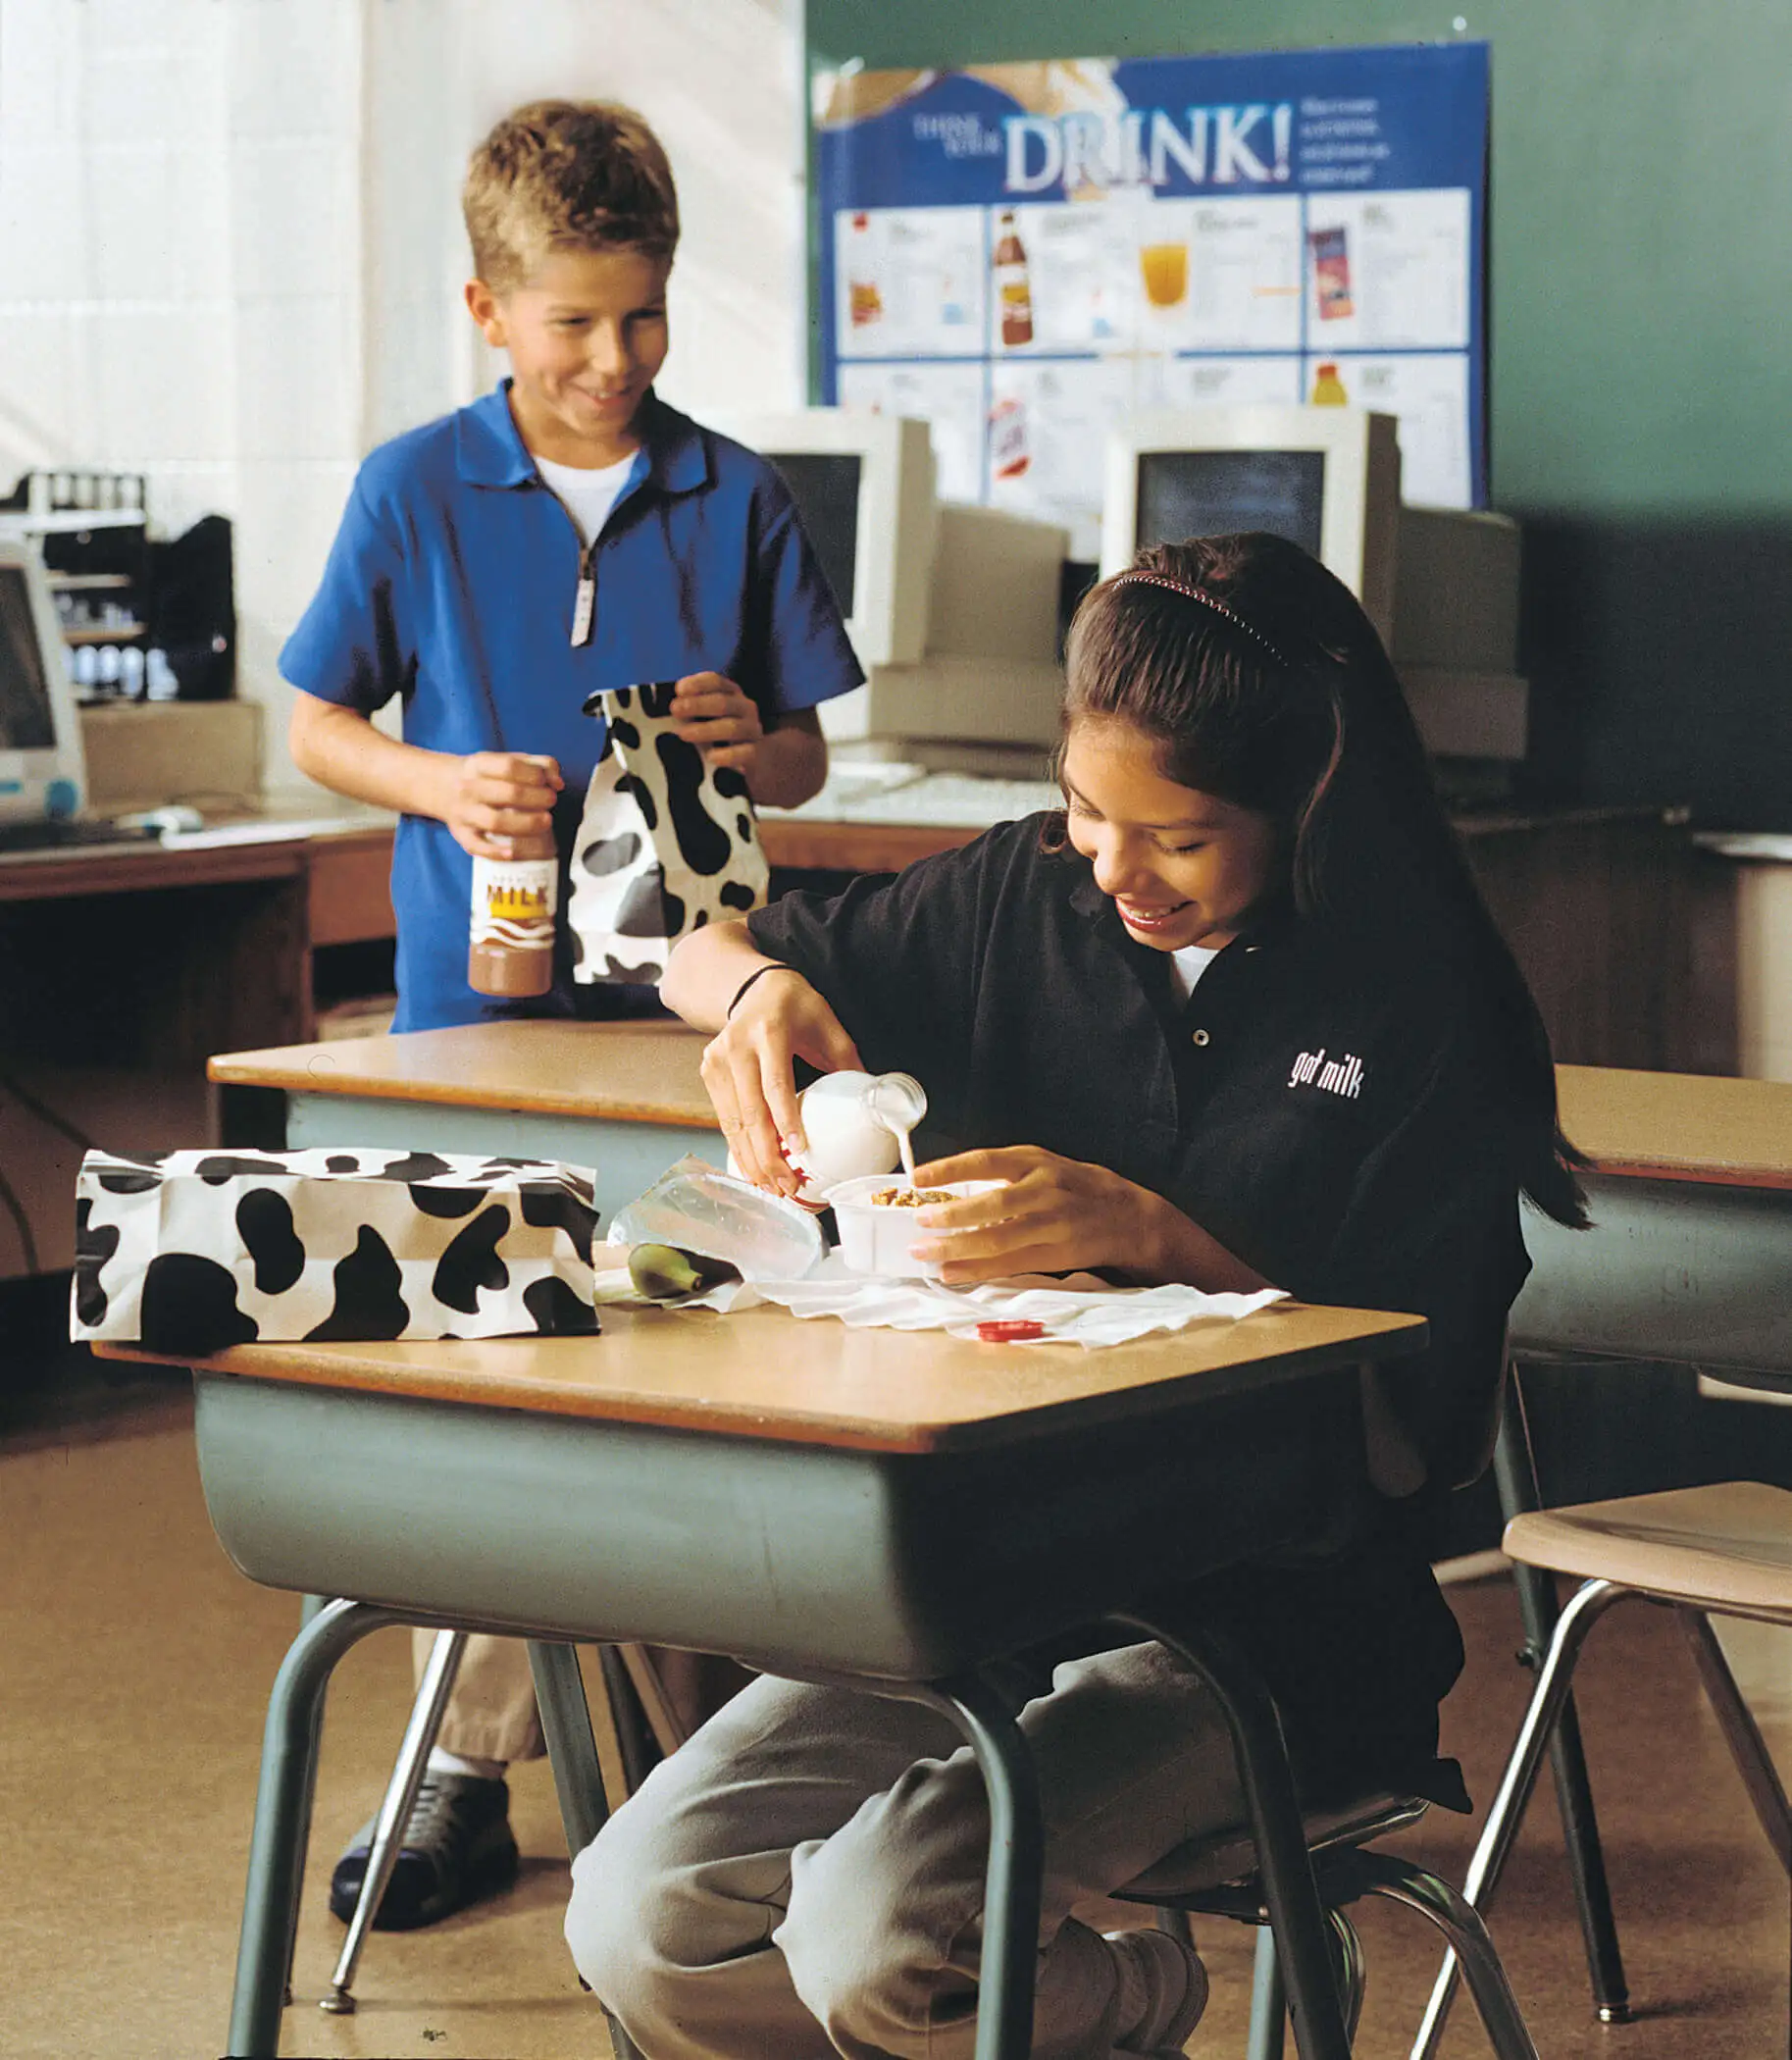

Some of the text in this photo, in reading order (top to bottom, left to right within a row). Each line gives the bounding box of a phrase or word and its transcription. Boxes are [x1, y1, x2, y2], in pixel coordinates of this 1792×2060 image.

[1003, 104, 1291, 192] DRINK!
[486, 884, 547, 905] MILK
[1288, 1049, 1364, 1100] got milk
